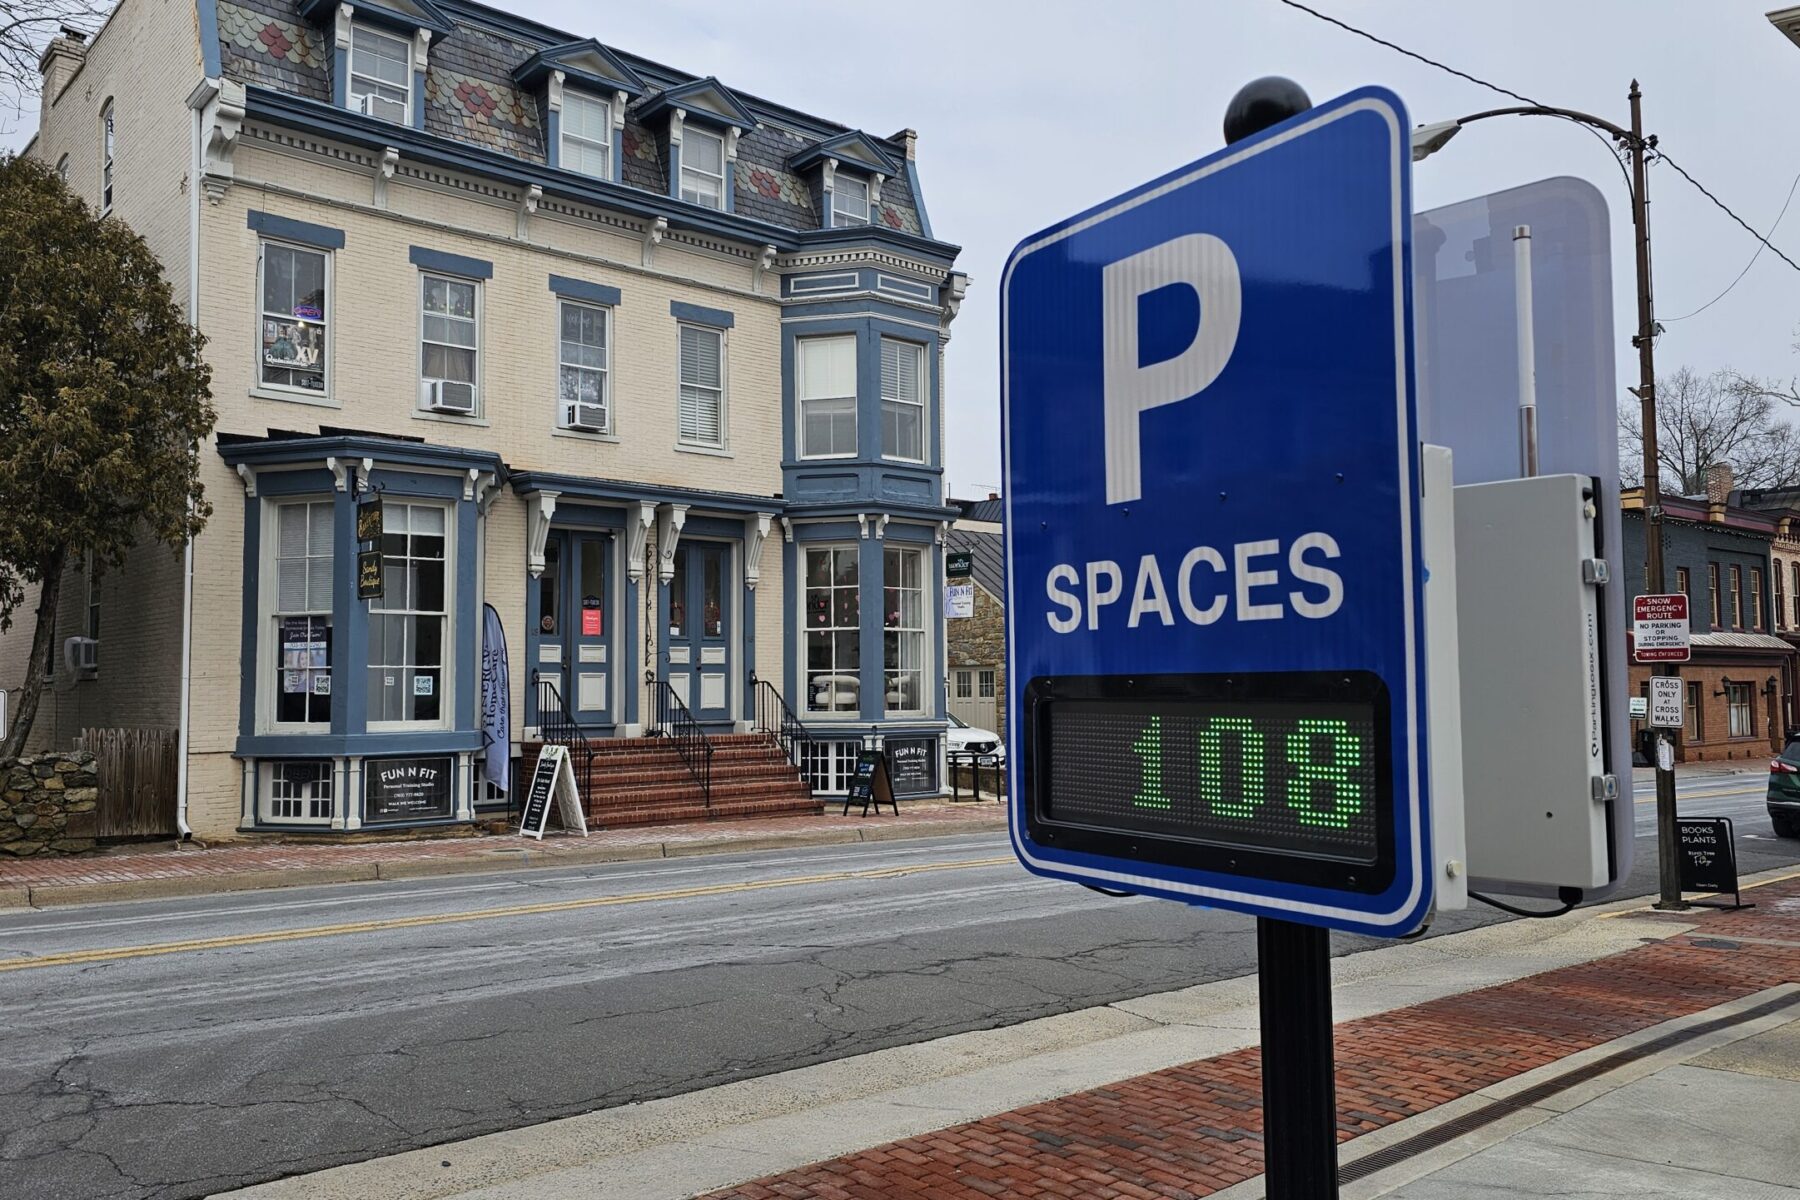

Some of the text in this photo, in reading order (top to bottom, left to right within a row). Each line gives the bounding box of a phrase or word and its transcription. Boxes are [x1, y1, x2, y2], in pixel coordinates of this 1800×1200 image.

[293, 306, 321, 316] OPEN
[1103, 233, 1242, 505] P
[1046, 531, 1344, 633] SPACES
[1637, 605, 1683, 613] EMERGENCY
[486, 649, 499, 727] HomeCare
[1655, 681, 1679, 689] CROSS
[1657, 690, 1676, 698] ONLY
[1654, 714, 1680, 722] WALKS
[497, 717, 505, 739] Care
[895, 746, 927, 758] FUN N FIT
[380, 767, 438, 782] FUN N FIT
[1132, 716, 1360, 828] 108
[1681, 826, 1714, 834] BOOKS
[1682, 836, 1717, 844] PLANTS
